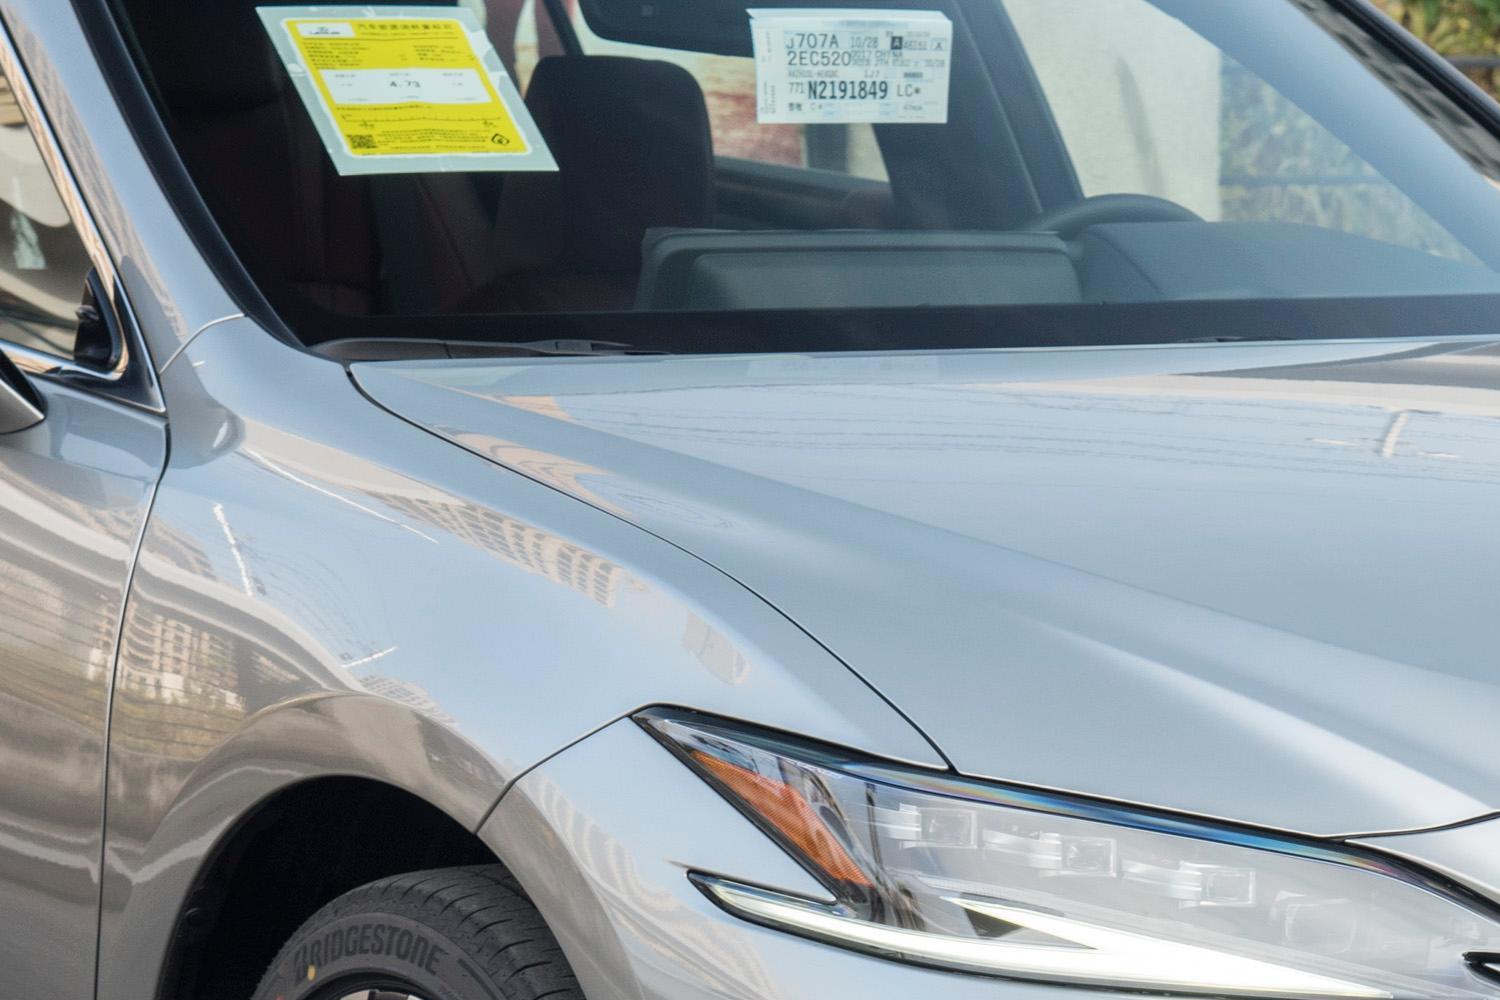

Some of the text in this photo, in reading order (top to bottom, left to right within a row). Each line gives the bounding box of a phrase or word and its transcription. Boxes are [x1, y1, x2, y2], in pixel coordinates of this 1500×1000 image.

[788, 51, 851, 66] 2EC520
[808, 80, 889, 100] N2191849
[293, 923, 448, 985] BRIDGESTONE
